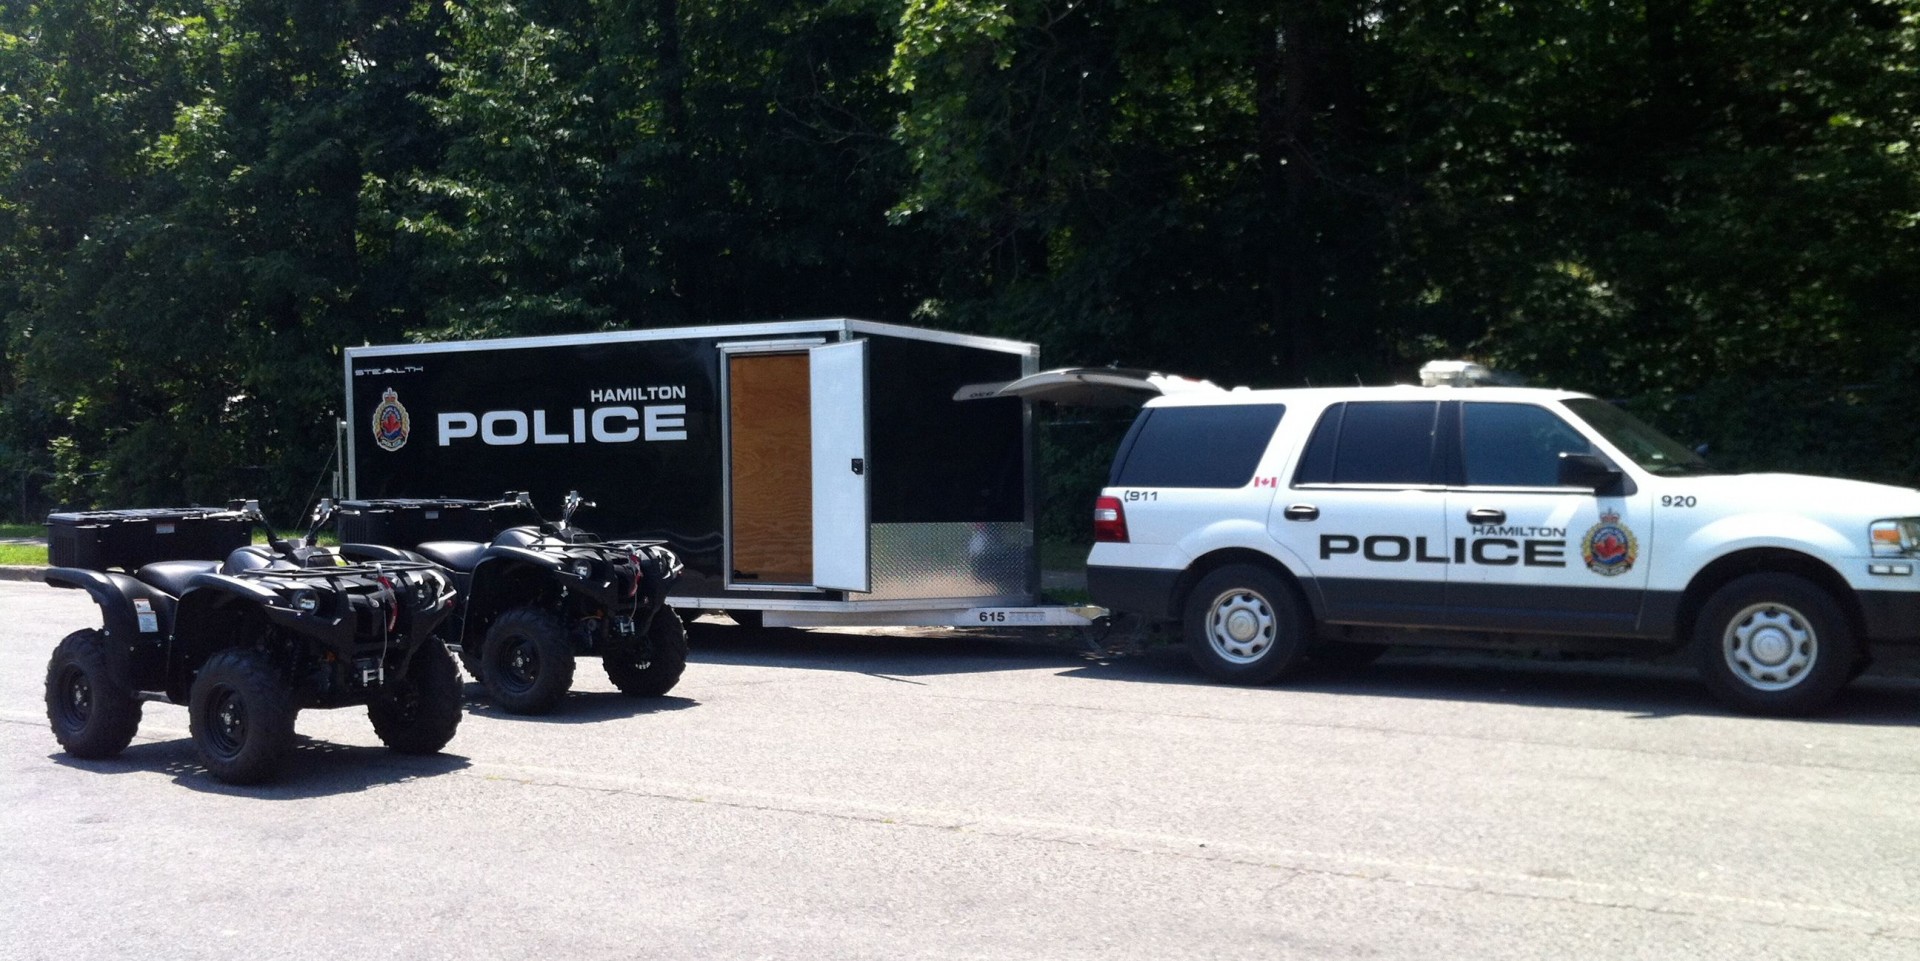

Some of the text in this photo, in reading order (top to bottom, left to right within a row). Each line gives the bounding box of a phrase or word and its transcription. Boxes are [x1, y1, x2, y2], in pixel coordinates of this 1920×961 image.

[590, 385, 686, 403] HAMILTON
[437, 404, 687, 447] POLICE
[1129, 491, 1158, 501] 911
[1661, 495, 1697, 508] 920
[1472, 525, 1566, 538] HAMILTON
[1319, 534, 1566, 568] POLICE
[979, 612, 1005, 622] 615
